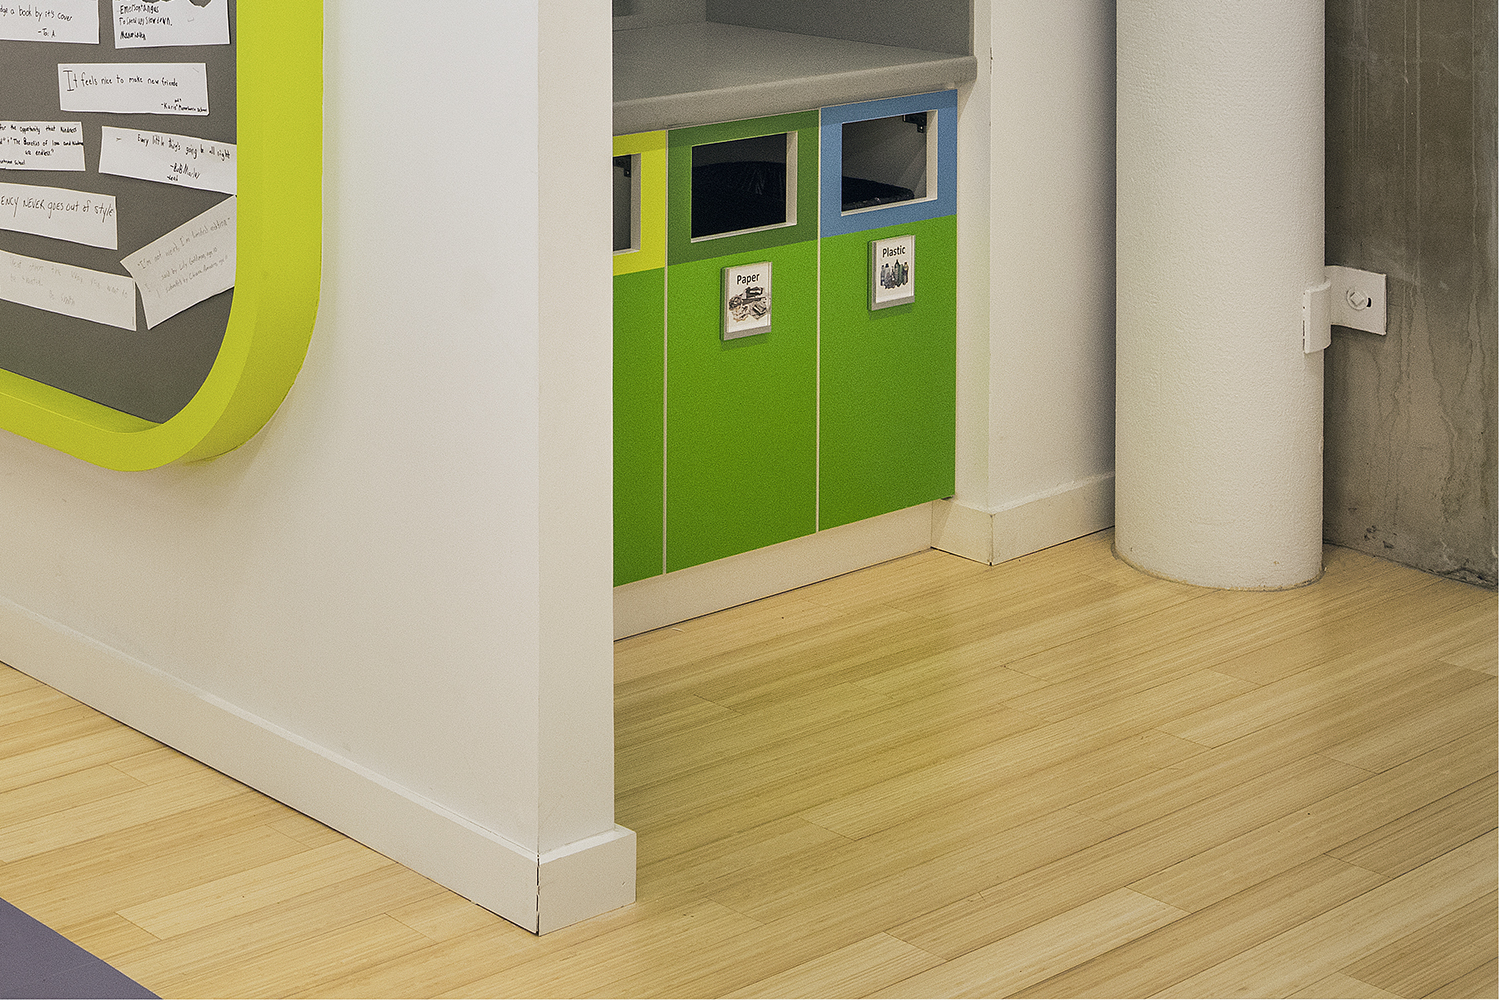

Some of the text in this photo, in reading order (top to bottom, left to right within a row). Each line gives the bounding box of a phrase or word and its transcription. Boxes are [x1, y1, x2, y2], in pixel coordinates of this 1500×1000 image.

[19, 5, 32, 16] book
[35, 6, 42, 22] by
[58, 12, 72, 22] cover
[63, 70, 78, 91] It
[81, 72, 98, 87] feels
[116, 74, 124, 84] to
[66, 202, 79, 212] out
[82, 200, 91, 212] of
[94, 203, 114, 222] style
[882, 244, 906, 258] Plastic
[736, 272, 760, 286] Paper
